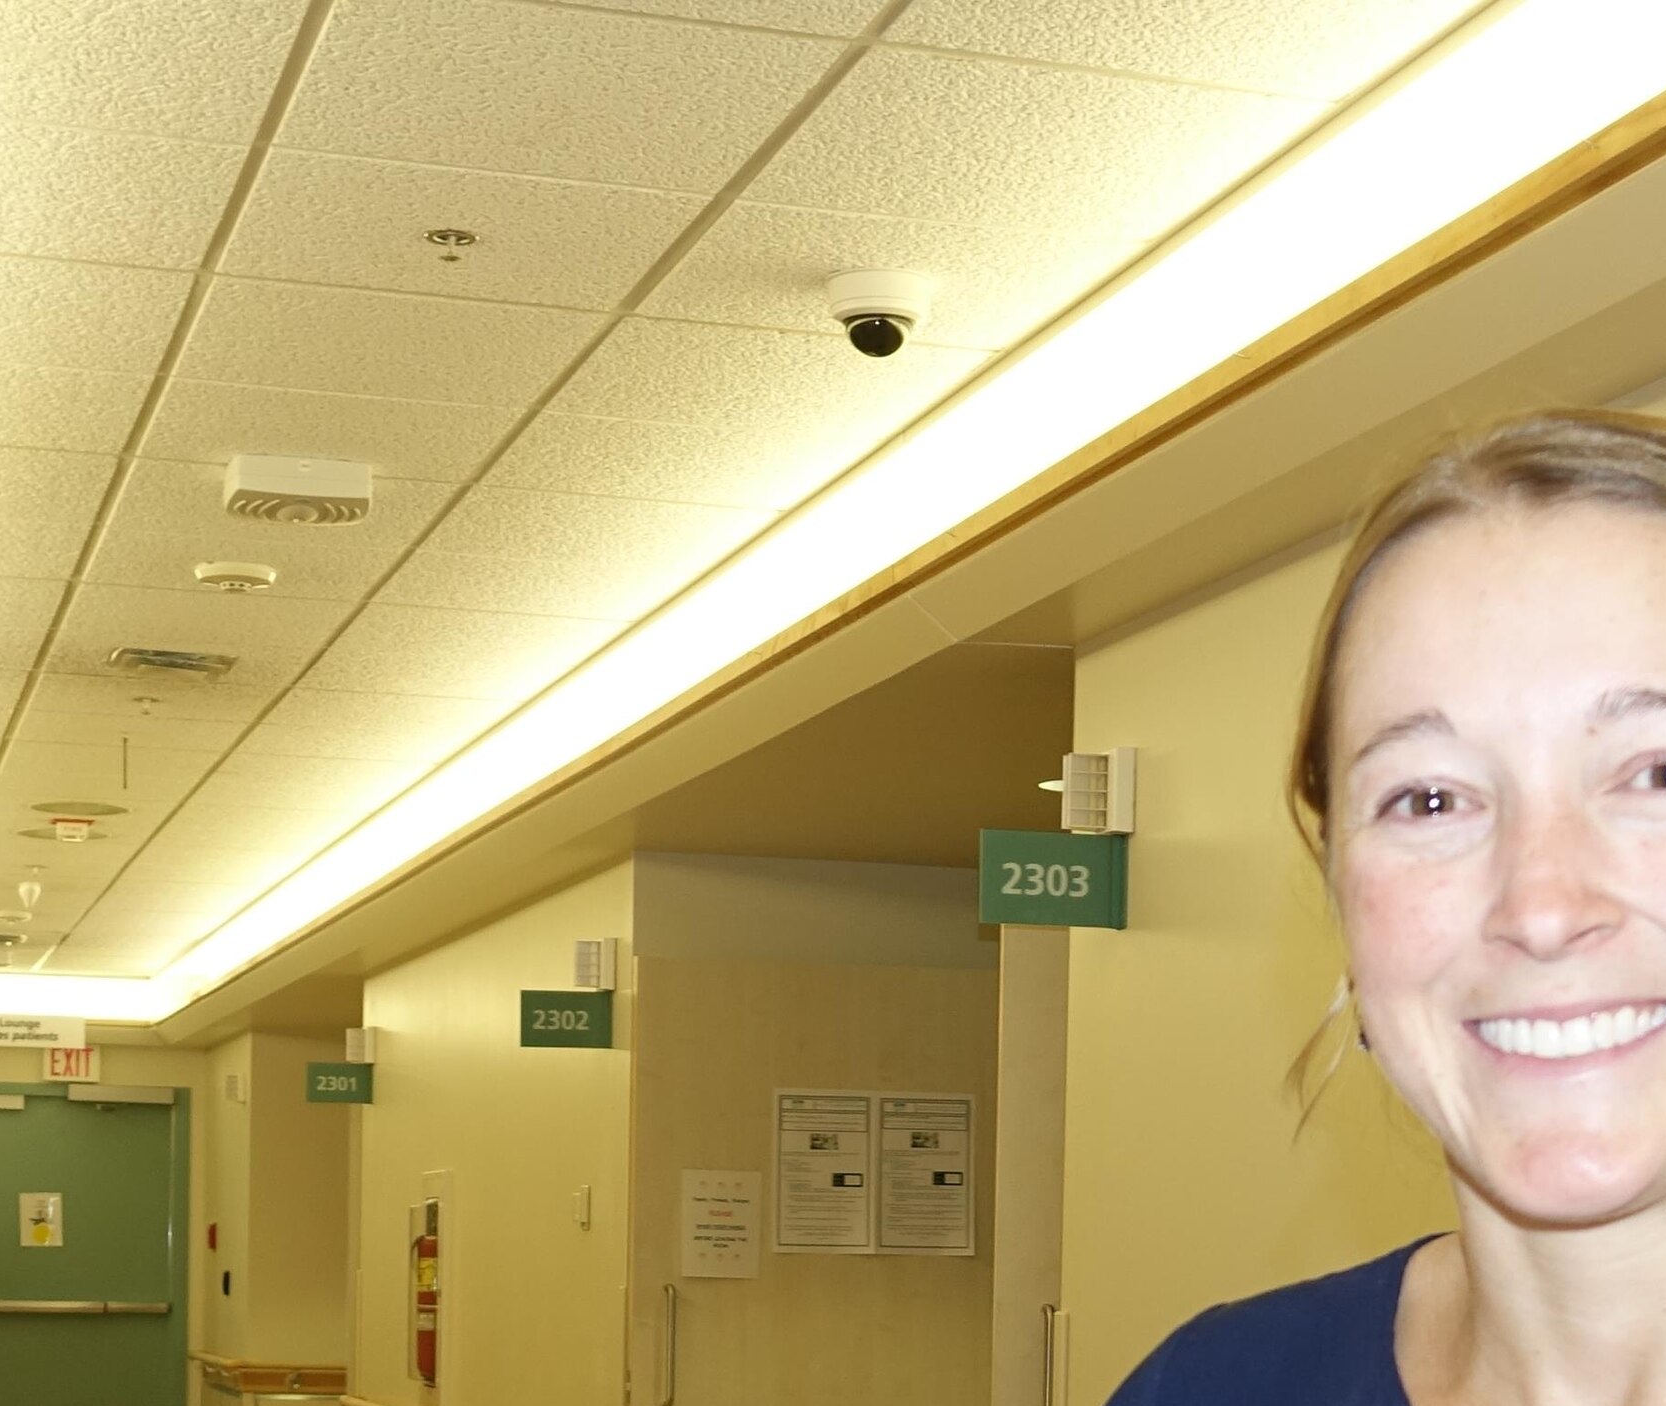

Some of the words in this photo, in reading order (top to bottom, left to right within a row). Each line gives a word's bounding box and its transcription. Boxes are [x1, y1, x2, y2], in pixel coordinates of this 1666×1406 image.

[1001, 862, 1090, 898] 2303
[532, 1009, 590, 1031] 2302
[12, 1030, 59, 1042] patients
[49, 1048, 94, 1077] EXIT
[316, 1075, 358, 1092] 2301
